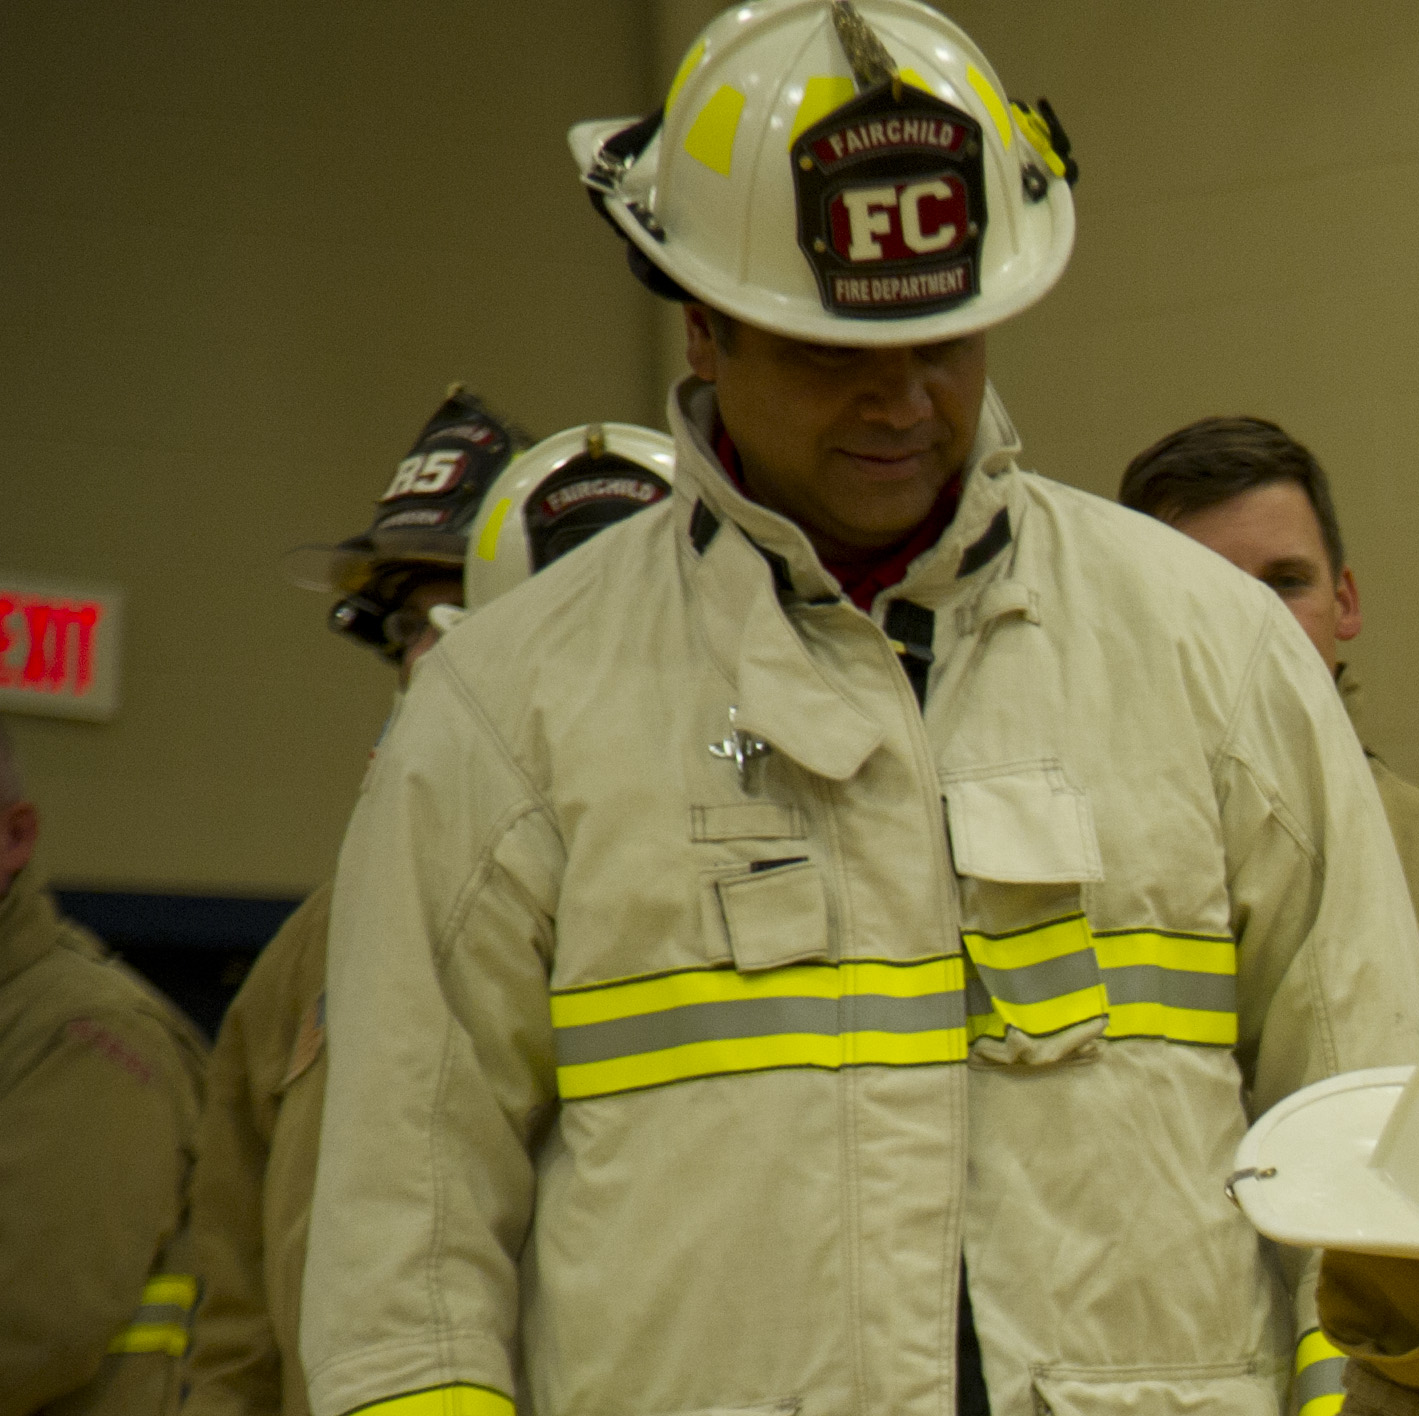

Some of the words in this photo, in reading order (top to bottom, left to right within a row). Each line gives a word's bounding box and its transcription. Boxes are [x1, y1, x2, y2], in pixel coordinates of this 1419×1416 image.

[828, 117, 954, 158] FAIRCHILD
[842, 179, 956, 262] FC
[834, 276, 870, 302] FIRE
[871, 266, 964, 301] DEPARTMENT
[546, 478, 656, 511] FAIRCHILD
